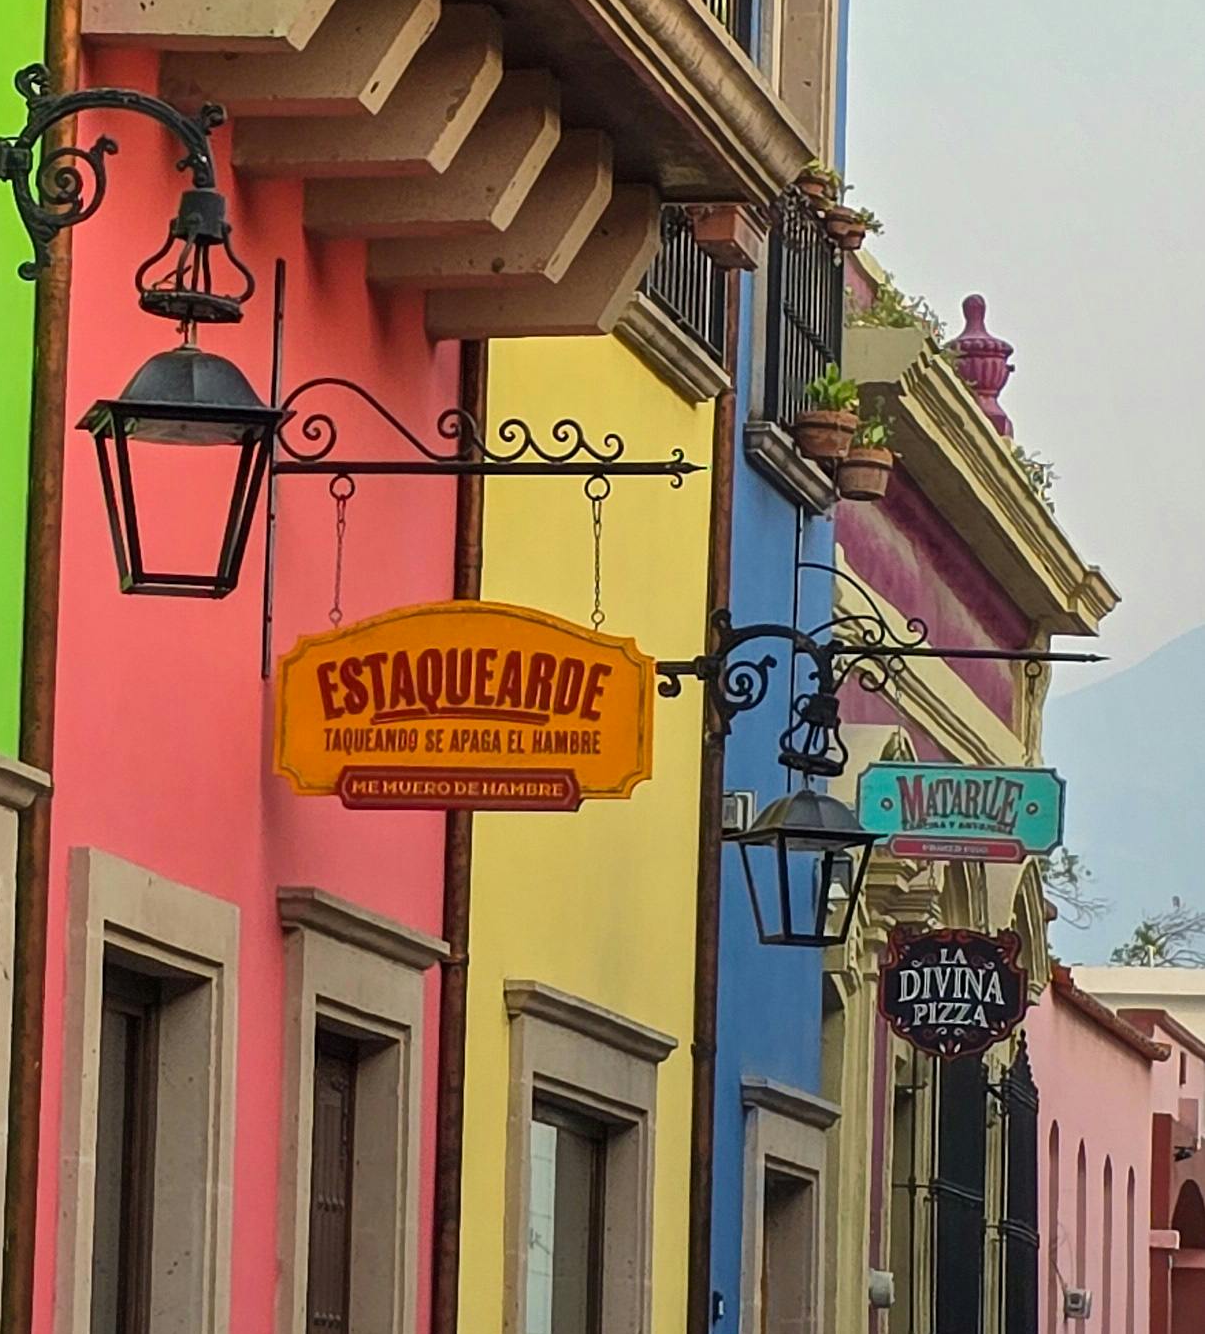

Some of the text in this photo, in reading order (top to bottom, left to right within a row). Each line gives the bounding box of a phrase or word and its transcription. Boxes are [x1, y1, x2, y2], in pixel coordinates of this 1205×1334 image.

[317, 648, 612, 721] ESTAQUEARDE
[324, 728, 602, 756] TAQUEANDO SE APAGA EL HAMBRE
[351, 779, 564, 798] ME MUERO DE HAMBRE
[897, 774, 1023, 831] MATARILE
[940, 948, 967, 965] LA
[898, 968, 1005, 1005] DIVINA
[912, 1002, 989, 1028] PIZZA
